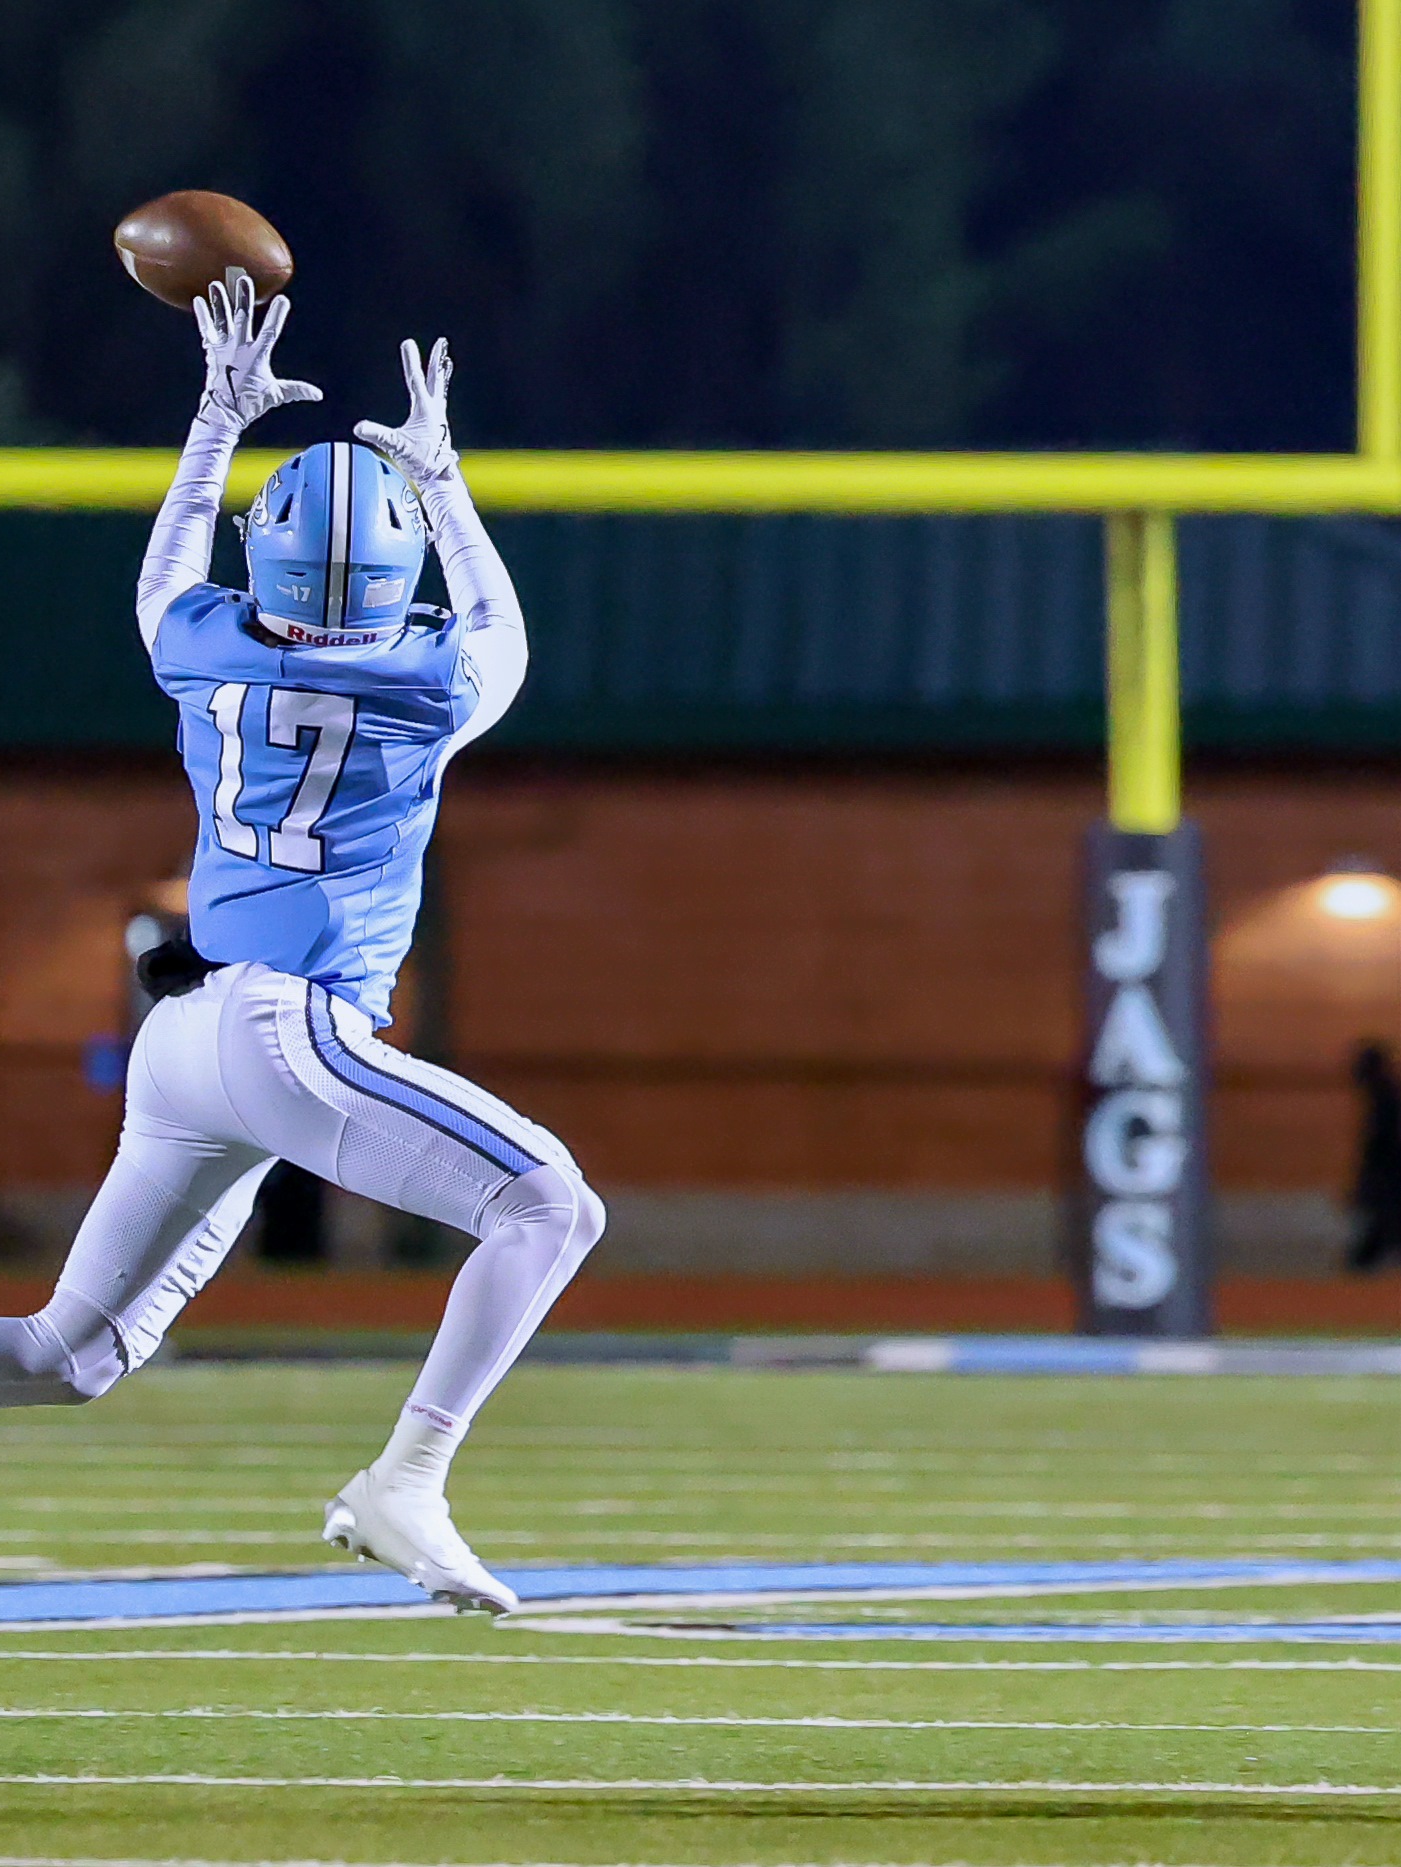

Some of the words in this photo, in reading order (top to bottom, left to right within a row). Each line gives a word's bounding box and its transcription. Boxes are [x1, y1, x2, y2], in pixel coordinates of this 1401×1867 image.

[287, 624, 377, 647] Riddell
[291, 584, 311, 602] 17
[207, 682, 356, 874] 17
[1085, 869, 1188, 1309] JAGS
